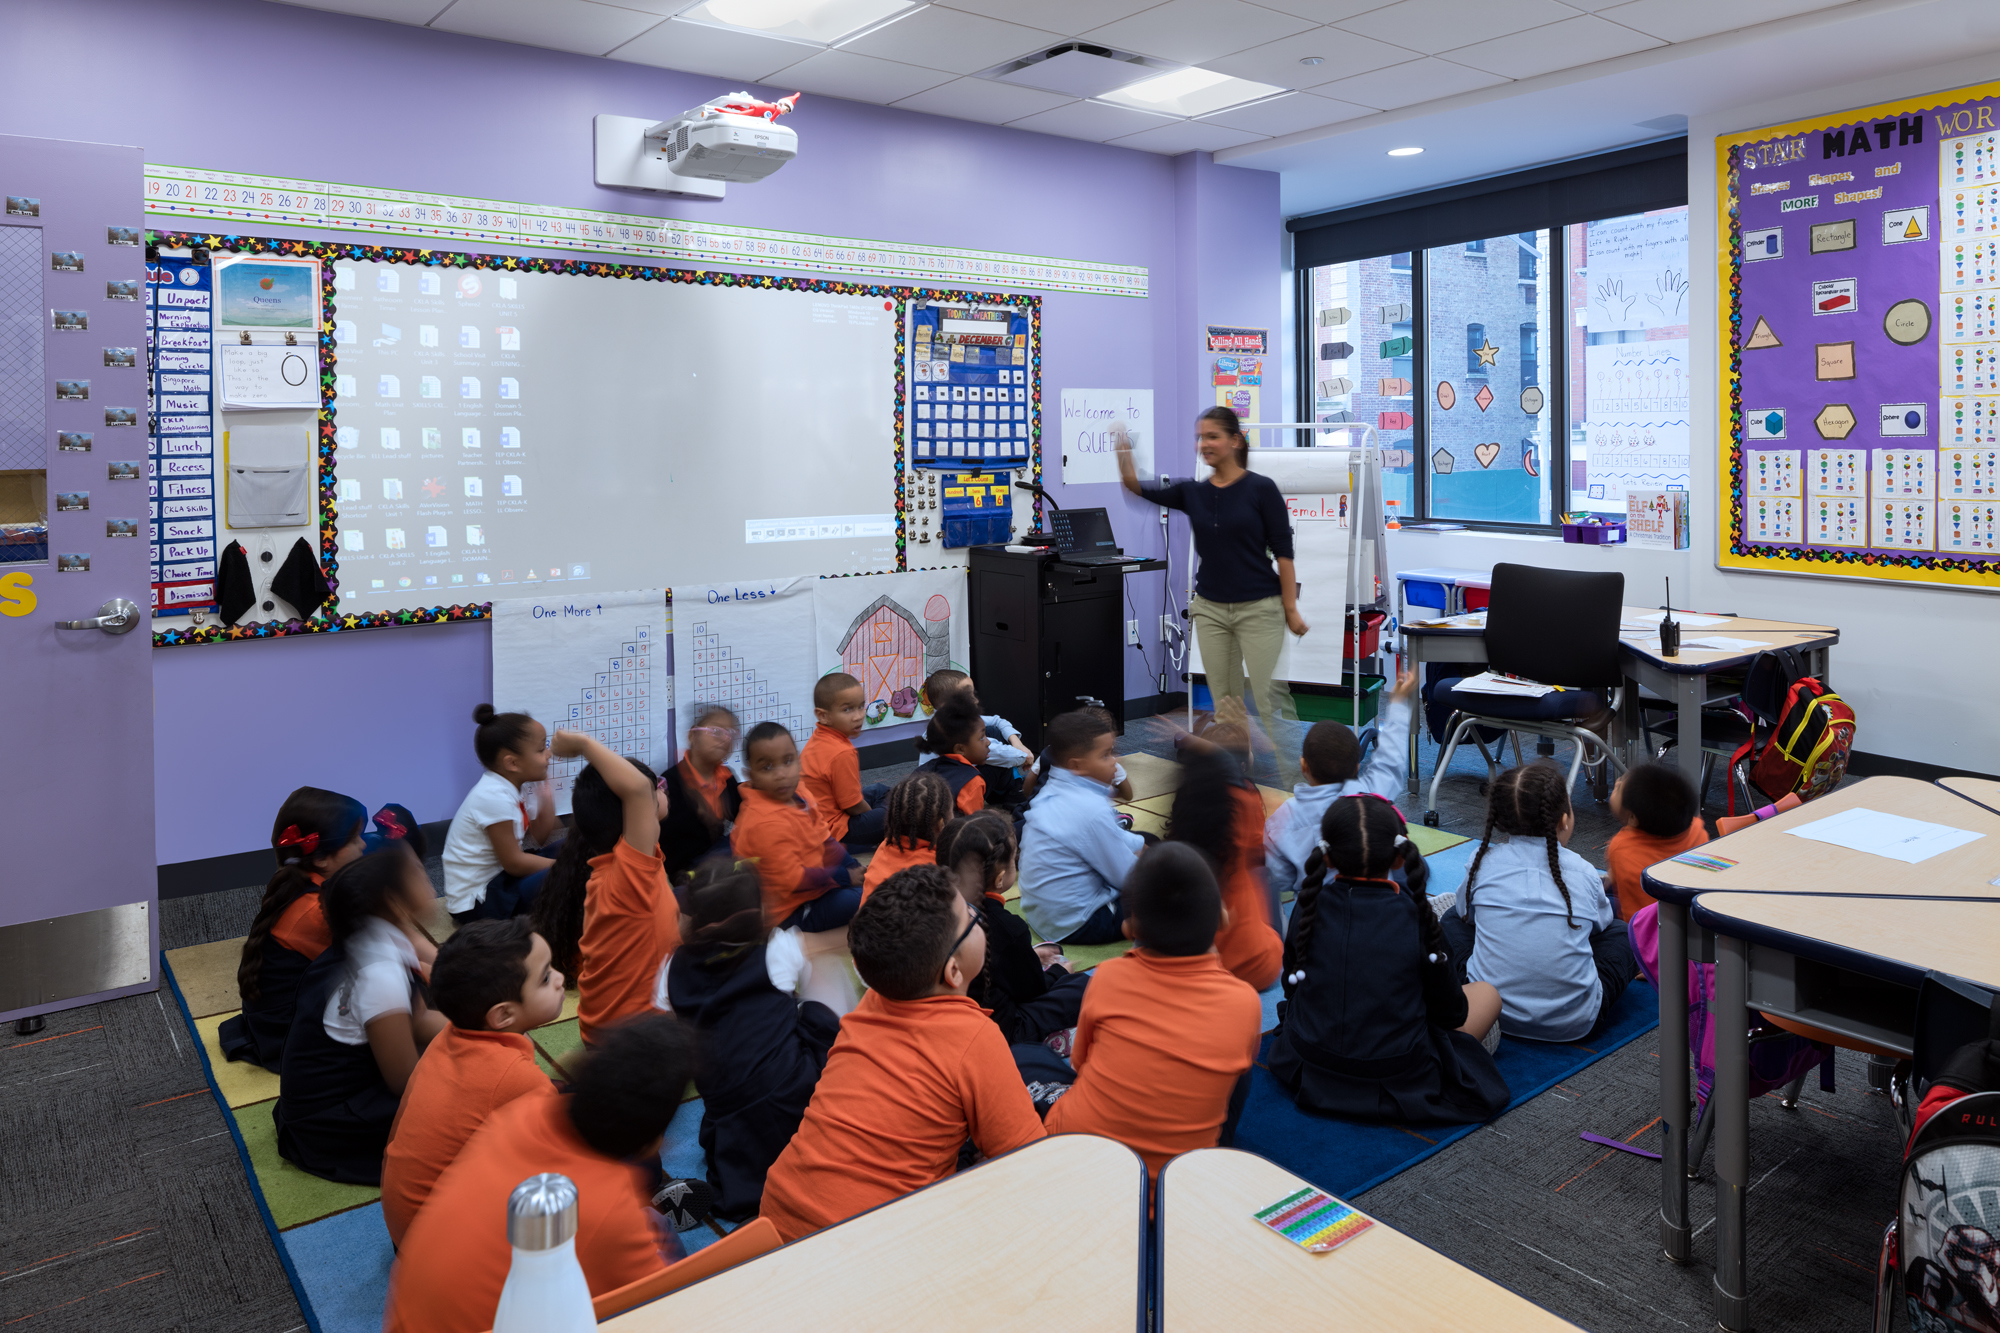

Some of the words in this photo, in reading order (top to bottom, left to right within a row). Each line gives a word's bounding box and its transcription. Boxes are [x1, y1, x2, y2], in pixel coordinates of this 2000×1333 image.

[1744, 138, 1806, 168] STAR
[1822, 115, 1923, 160] MATH
[1875, 162, 1900, 177] and
[1782, 197, 1818, 211] MORE
[1834, 186, 1883, 204] Shapes!
[148, 181, 161, 195] 19
[165, 182, 181, 197] 20
[185, 184, 198, 199] 21
[204, 186, 218, 201] 22
[223, 188, 237, 203] 23
[241, 190, 255, 204] 24
[260, 192, 274, 206] 25
[278, 193, 292, 208] 26
[295, 195, 309, 209] 27
[313, 197, 327, 211] 28
[331, 199, 345, 212] 29
[348, 200, 362, 214] 30
[365, 202, 377, 216] 31
[382, 204, 395, 218] 32
[398, 207, 411, 219] 33
[414, 207, 427, 221] 34
[430, 209, 442, 222] 35
[446, 210, 458, 224] 36
[461, 212, 473, 224] 37
[476, 213, 489, 227] 38
[491, 215, 503, 227] 39
[506, 216, 518, 229] 40
[1610, 225, 1628, 234] count
[1630, 222, 1644, 231] with
[1657, 218, 1679, 229] fingers
[1888, 219, 1903, 229] Cone
[1816, 231, 1851, 244] Rectangle
[1605, 246, 1620, 254] count
[1645, 239, 1663, 250] fingers
[1664, 235, 1677, 244] with
[167, 293, 208, 306] Unpack
[253, 296, 282, 304] Queens
[159, 313, 191, 323] Morning
[947, 309, 972, 320] TODAY'S
[1895, 319, 1914, 327] Circle
[161, 335, 209, 347] Breakfast
[959, 335, 1003, 345] DECEMBER
[1210, 336, 1232, 347] Calling
[1234, 336, 1243, 346] All
[1244, 336, 1262, 346] Hands
[1754, 332, 1772, 341] Triangle
[257, 349, 268, 358] big
[1616, 346, 1643, 358] Number
[1648, 345, 1672, 356] Lines
[160, 354, 189, 363] Morning
[1218, 359, 1239, 369] Library
[1821, 357, 1843, 367] Square
[162, 375, 195, 385] Singapore
[166, 399, 199, 409] Music
[1063, 398, 1116, 419] Welcome
[1126, 397, 1141, 419] to
[1823, 417, 1849, 428] Hexagon
[166, 440, 203, 452] Lunch
[1077, 428, 1134, 454] QUEENS
[169, 462, 205, 473] Recess
[169, 483, 206, 495] Fitness
[976, 496, 981, 506] 6
[997, 495, 1002, 505] 6
[164, 505, 184, 514] CKLA
[1286, 497, 1335, 518] Female
[1629, 500, 1648, 513] ELF
[169, 525, 204, 536] Snack
[1629, 519, 1664, 533] SHELF
[1633, 532, 1652, 540] Christmas
[169, 546, 194, 557] Pack
[196, 546, 208, 556] Up
[164, 568, 191, 579] Choice
[195, 566, 214, 577] Time
[170, 586, 213, 600] Dismissal
[707, 589, 730, 604] One
[735, 588, 766, 601] Less
[532, 605, 559, 620] One
[564, 604, 592, 618] More
[639, 631, 647, 639] 10
[696, 625, 705, 634] 10
[627, 645, 635, 654] 9
[613, 660, 620, 670] 8
[585, 691, 593, 700] 6
[571, 708, 579, 718] 5
